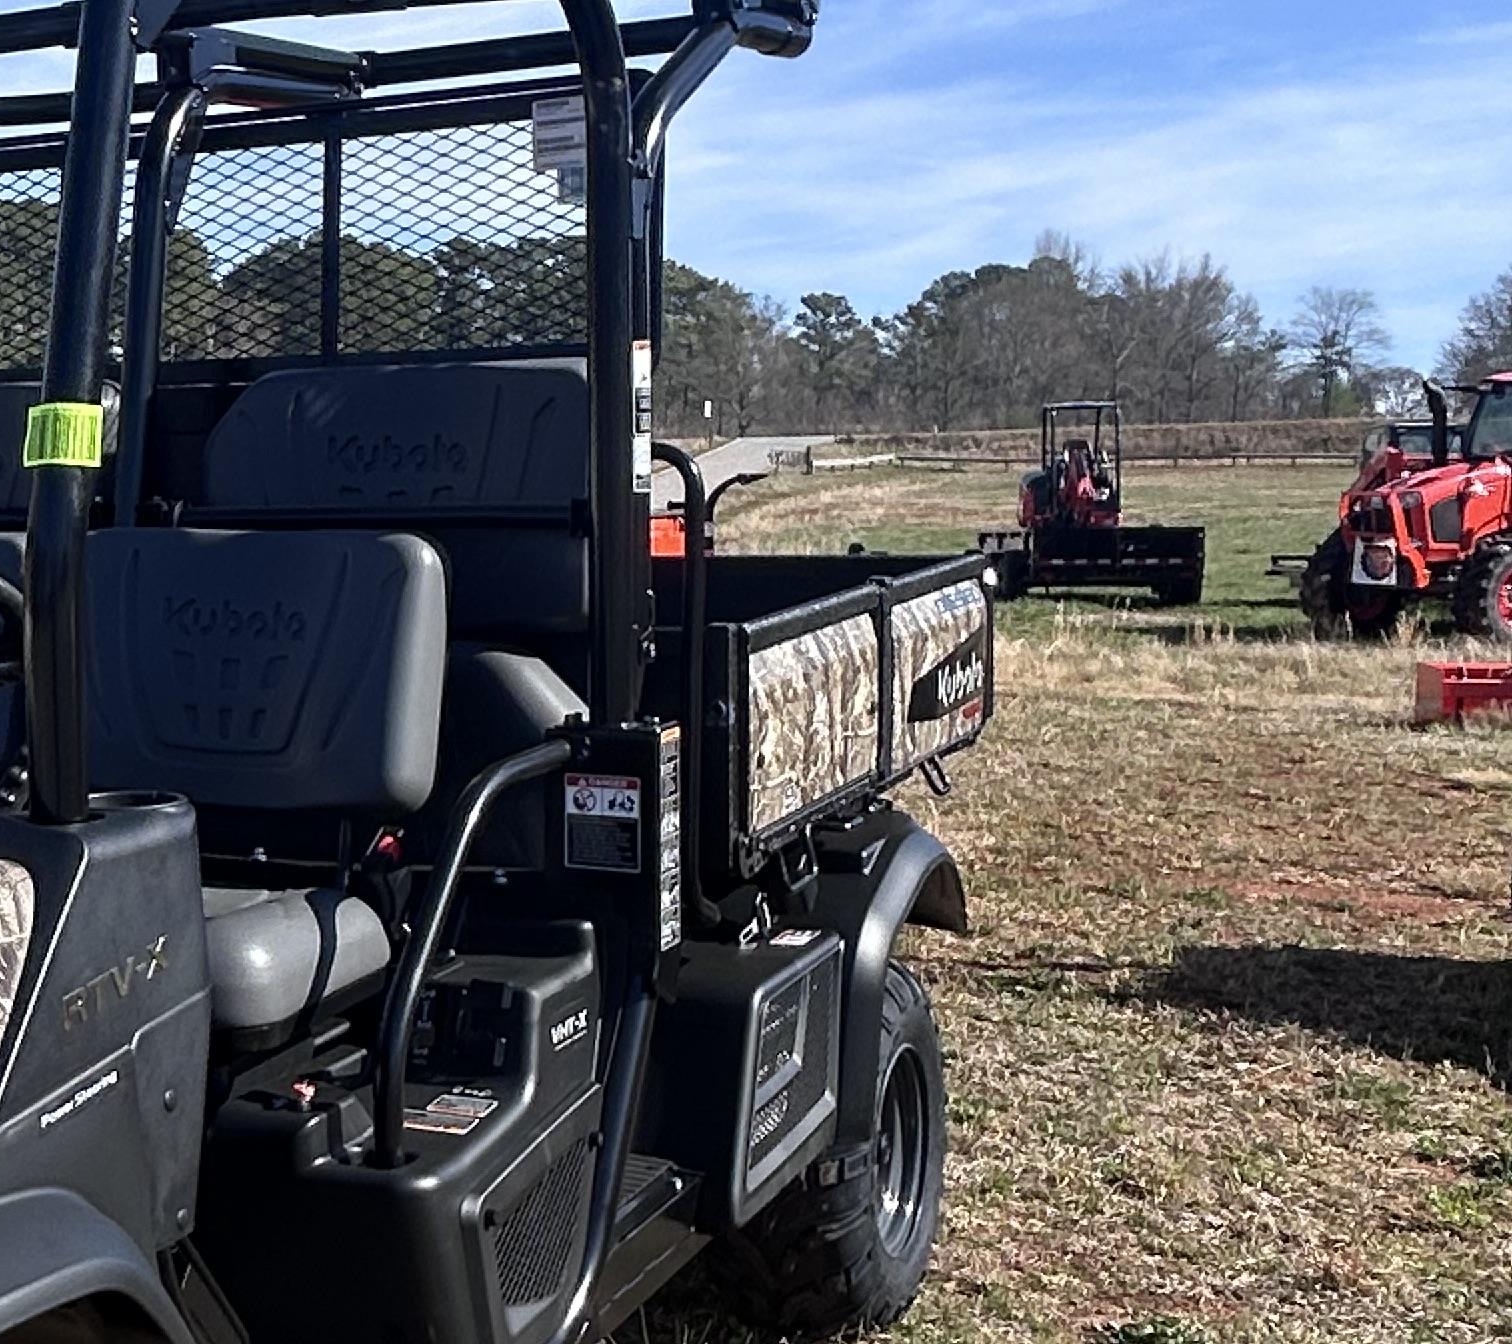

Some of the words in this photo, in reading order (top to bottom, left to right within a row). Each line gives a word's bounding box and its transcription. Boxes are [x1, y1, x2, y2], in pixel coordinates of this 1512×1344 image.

[327, 433, 468, 474] Kubota
[163, 596, 306, 640] Kubota
[62, 933, 168, 1032] RTV-X
[40, 1099, 74, 1128] Power
